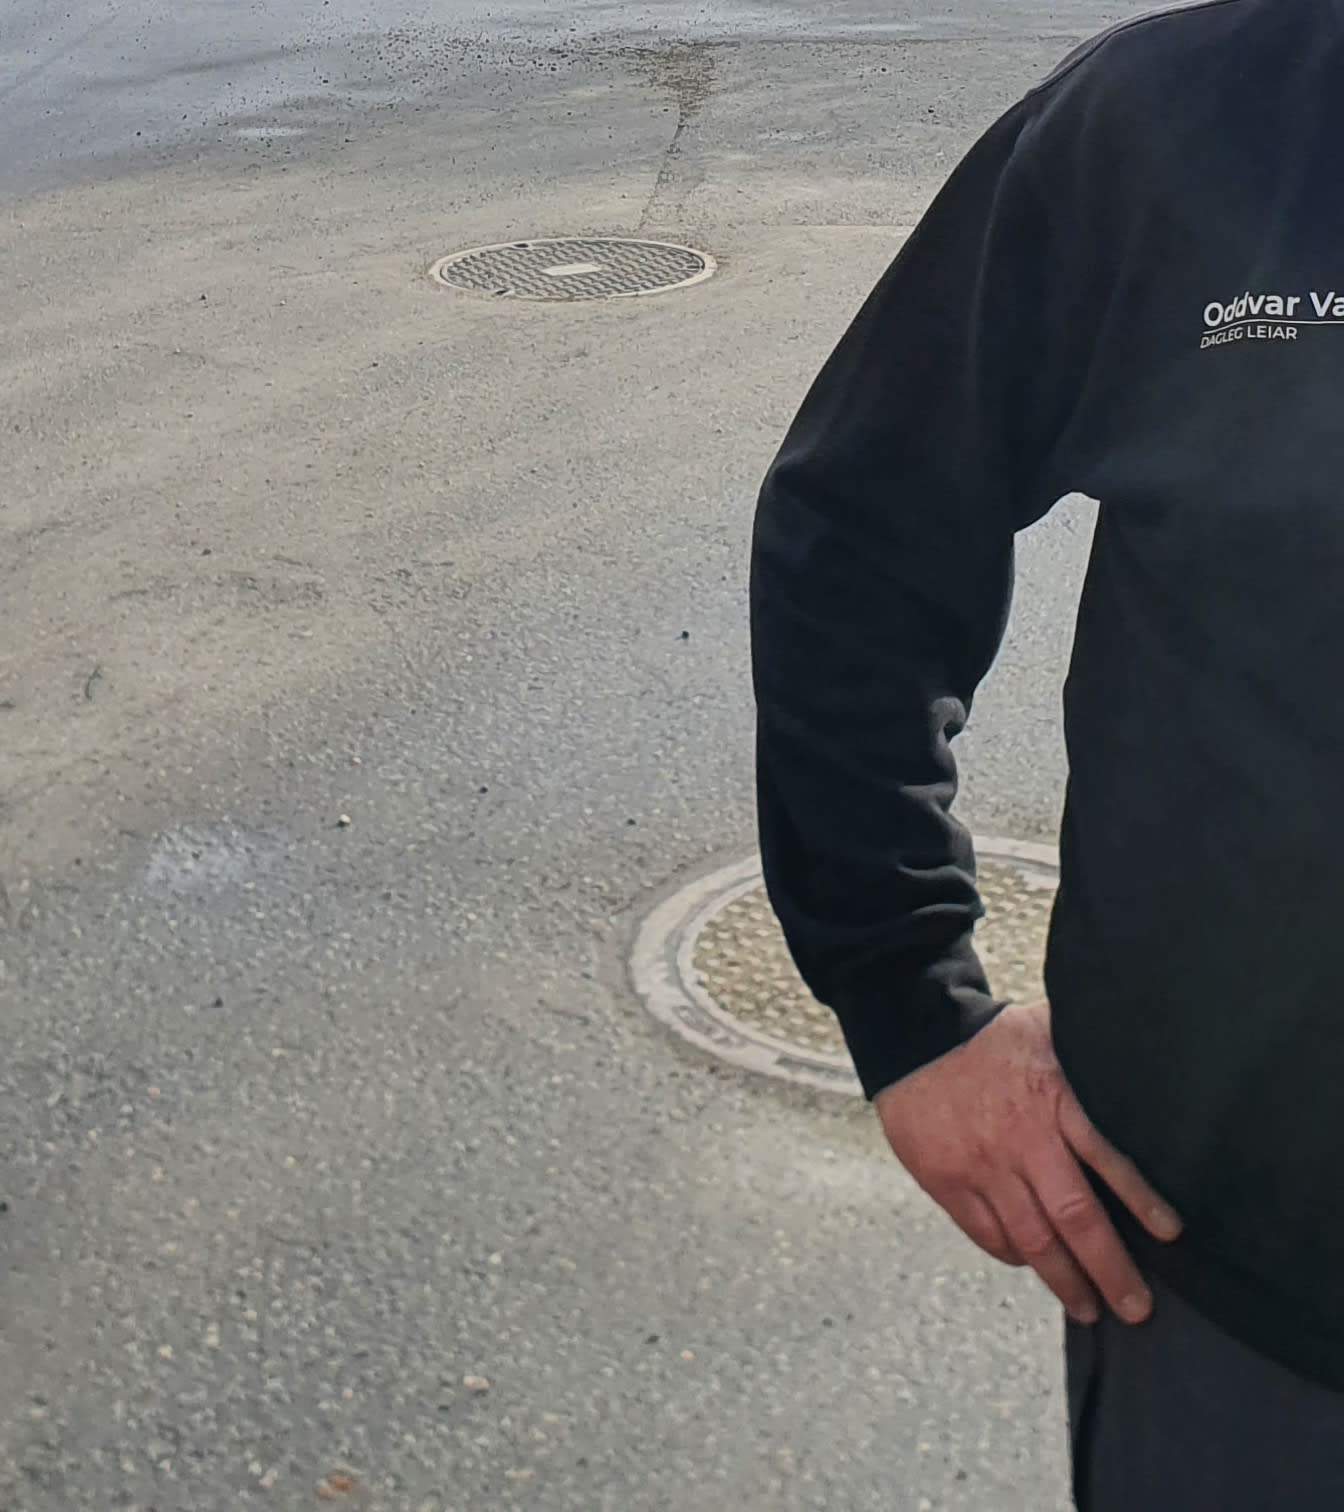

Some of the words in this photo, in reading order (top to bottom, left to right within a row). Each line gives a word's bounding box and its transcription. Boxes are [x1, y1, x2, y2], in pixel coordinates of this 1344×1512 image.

[1203, 291, 1300, 327] Oddvar
[1200, 327, 1243, 348] DAGLEG
[1247, 325, 1298, 340] LEIAR
